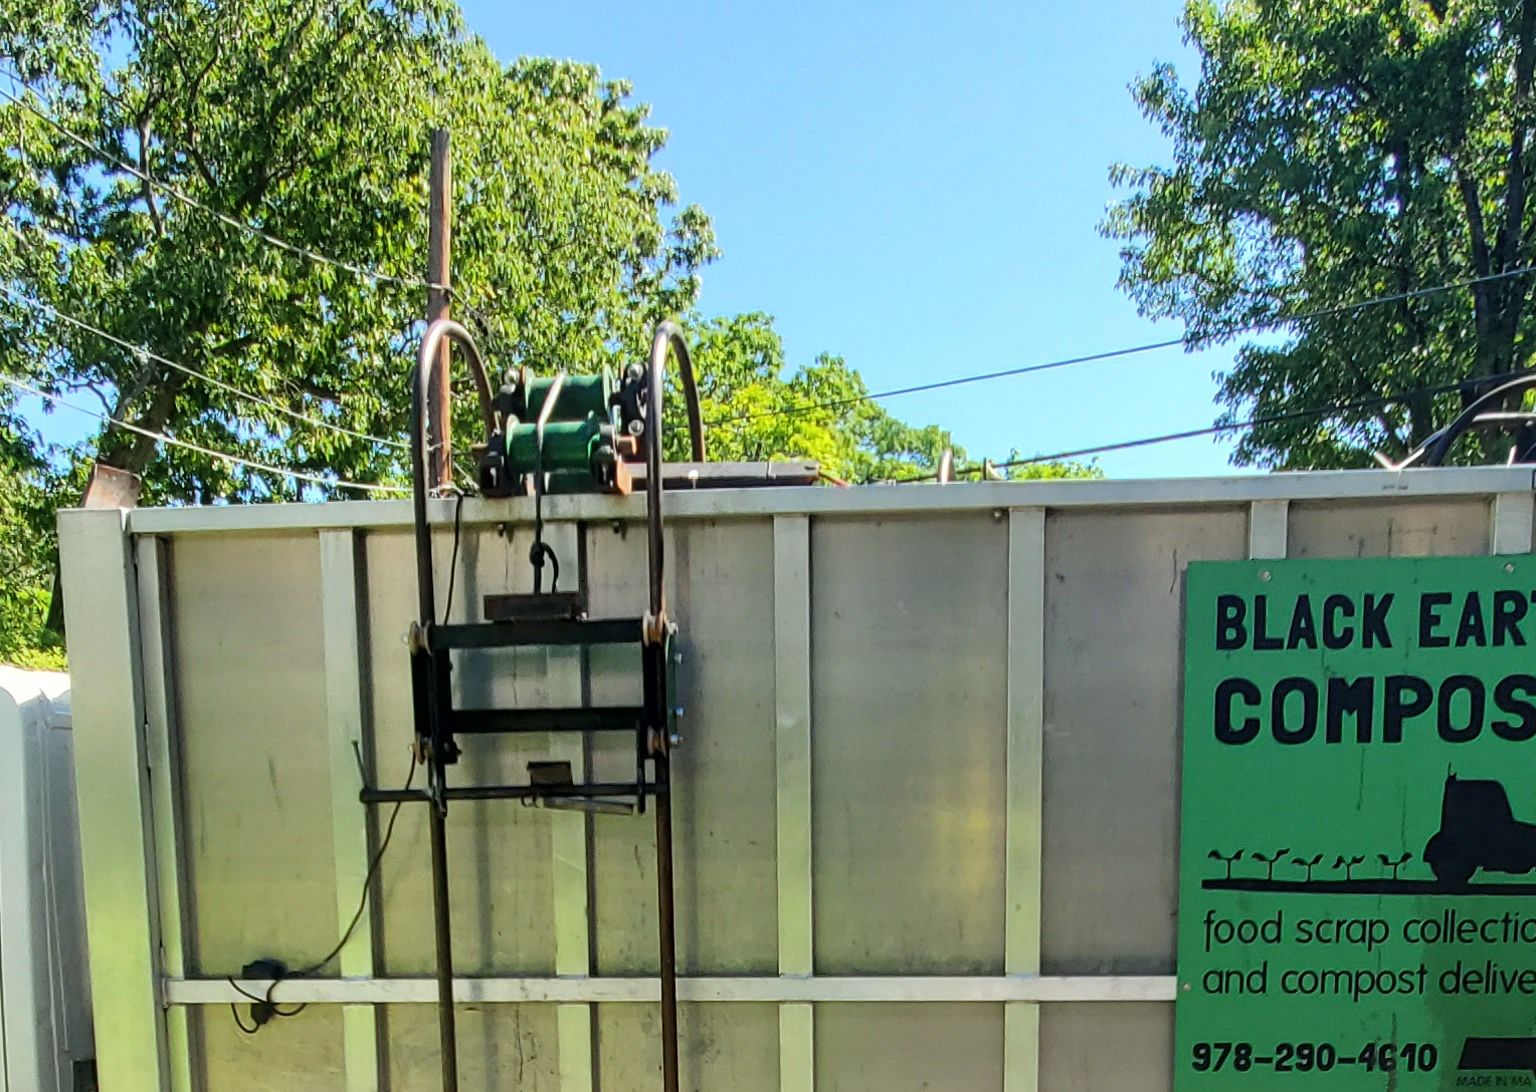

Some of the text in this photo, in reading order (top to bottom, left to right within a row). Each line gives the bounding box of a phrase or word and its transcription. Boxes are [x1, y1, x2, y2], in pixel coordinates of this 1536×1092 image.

[1215, 592, 1395, 651] BLACK
[1202, 909, 1283, 953] food
[1294, 917, 1390, 953] scrap
[1202, 960, 1268, 995] and
[1280, 963, 1428, 1003] compost
[1191, 1042, 1439, 1073] 978-290-4610
